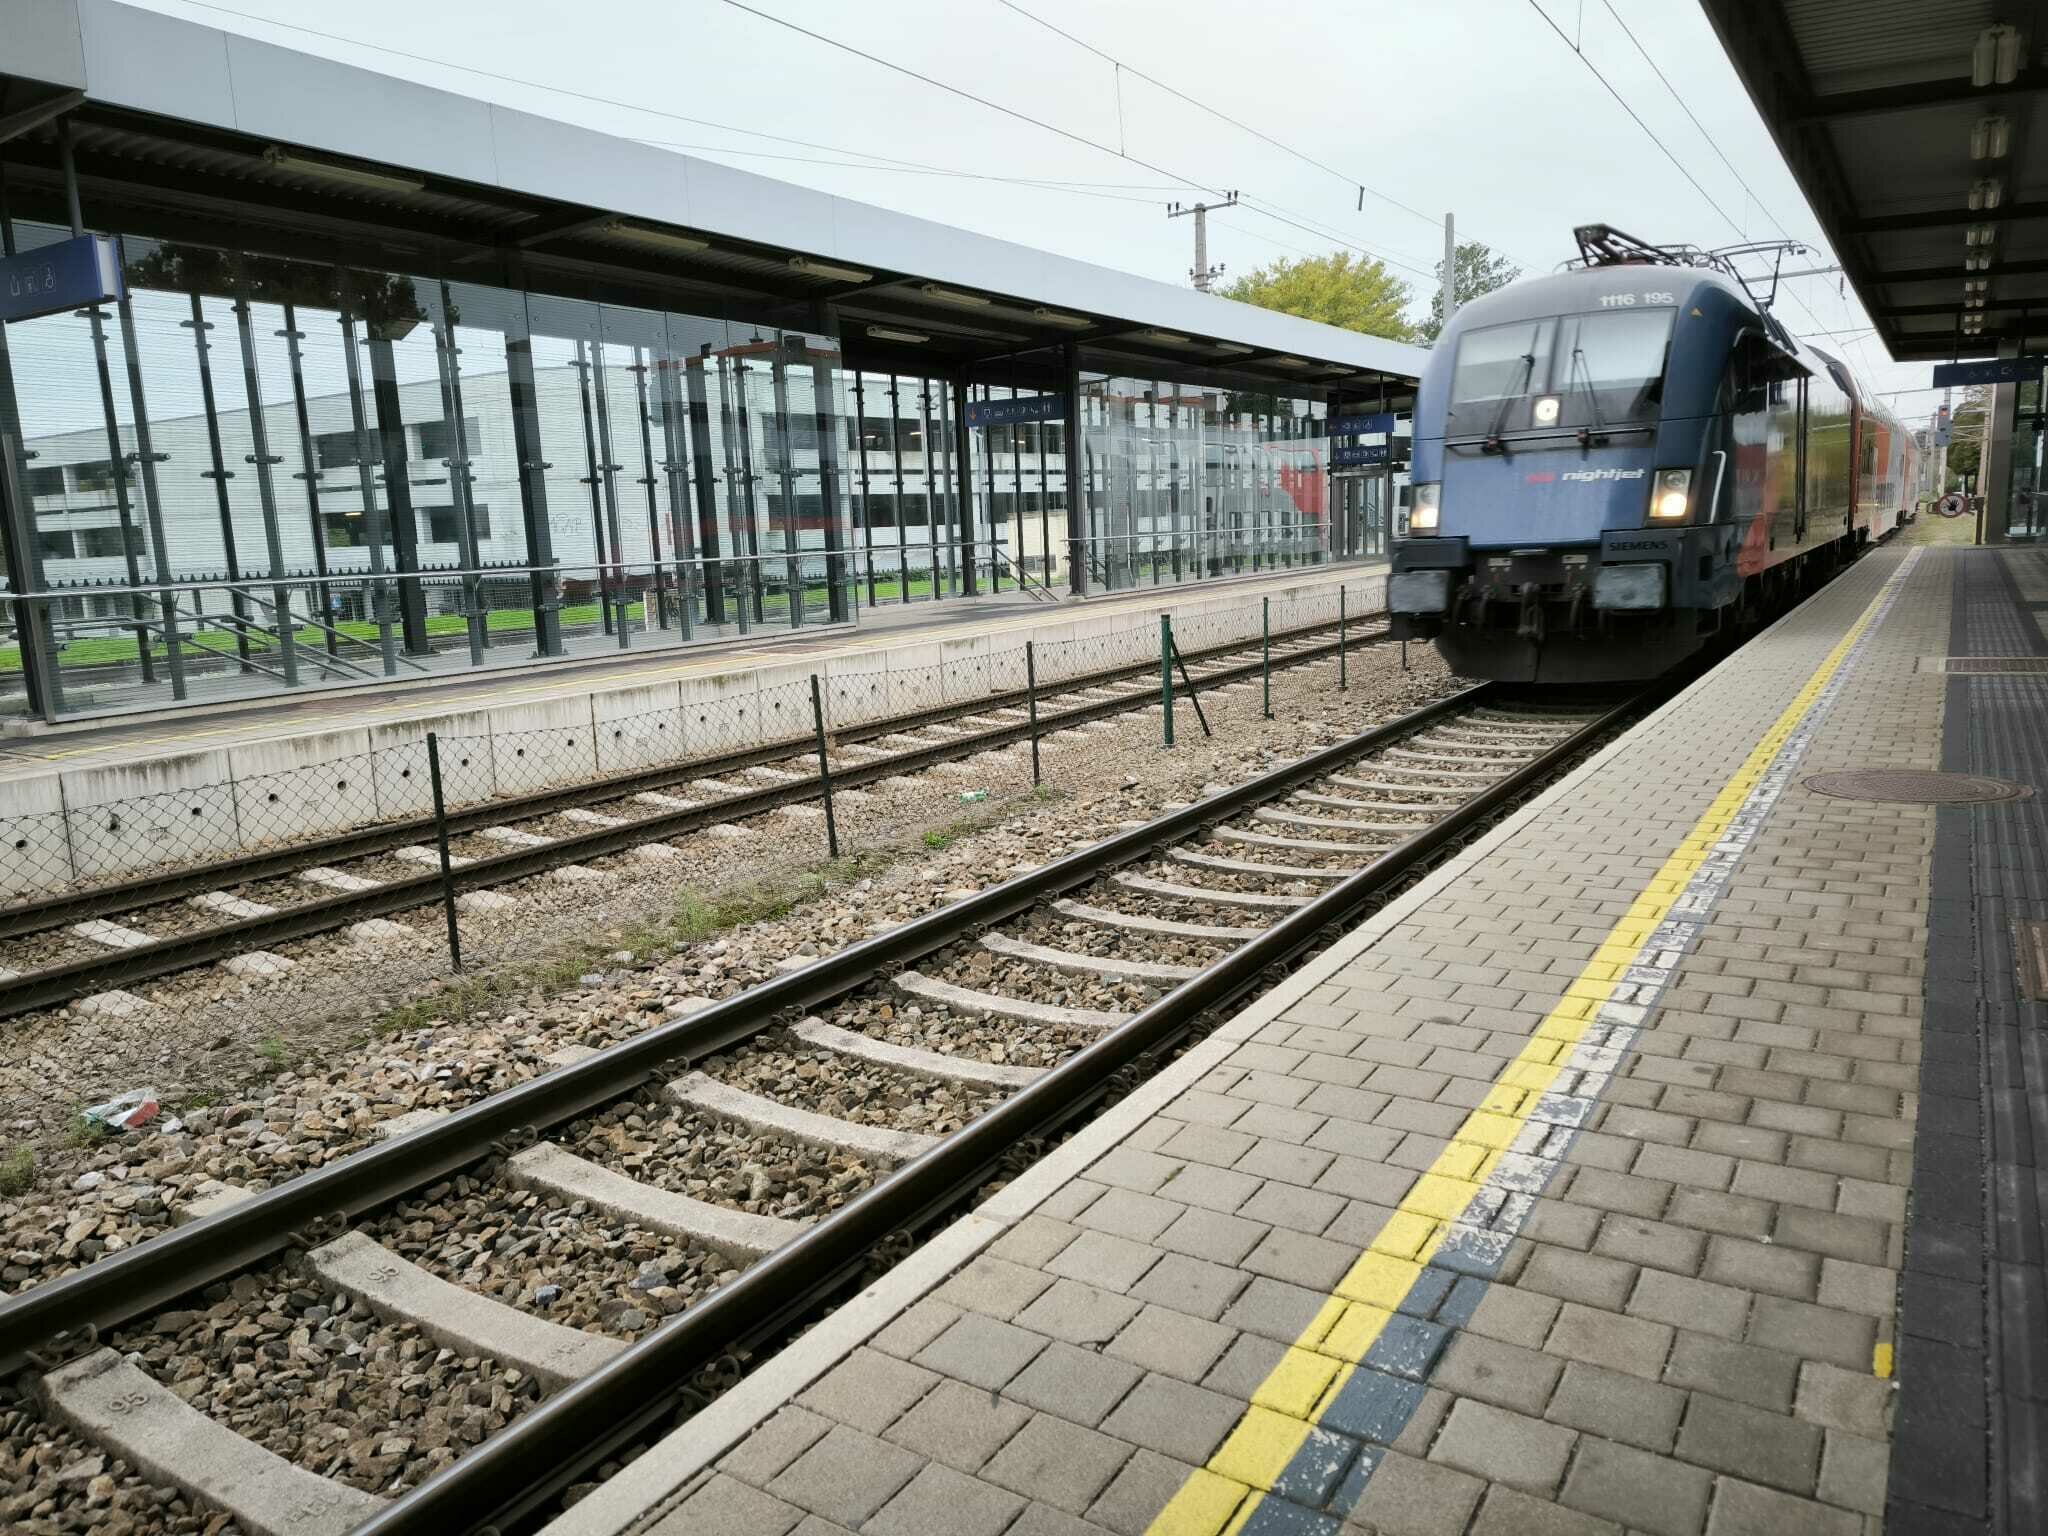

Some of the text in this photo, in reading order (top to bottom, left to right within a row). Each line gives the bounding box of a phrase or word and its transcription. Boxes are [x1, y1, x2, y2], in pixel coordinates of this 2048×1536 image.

[1600, 291, 1674, 307] 1116 195
[1562, 468, 1646, 482] nightjet
[1608, 540, 1669, 551] SIEMENS
